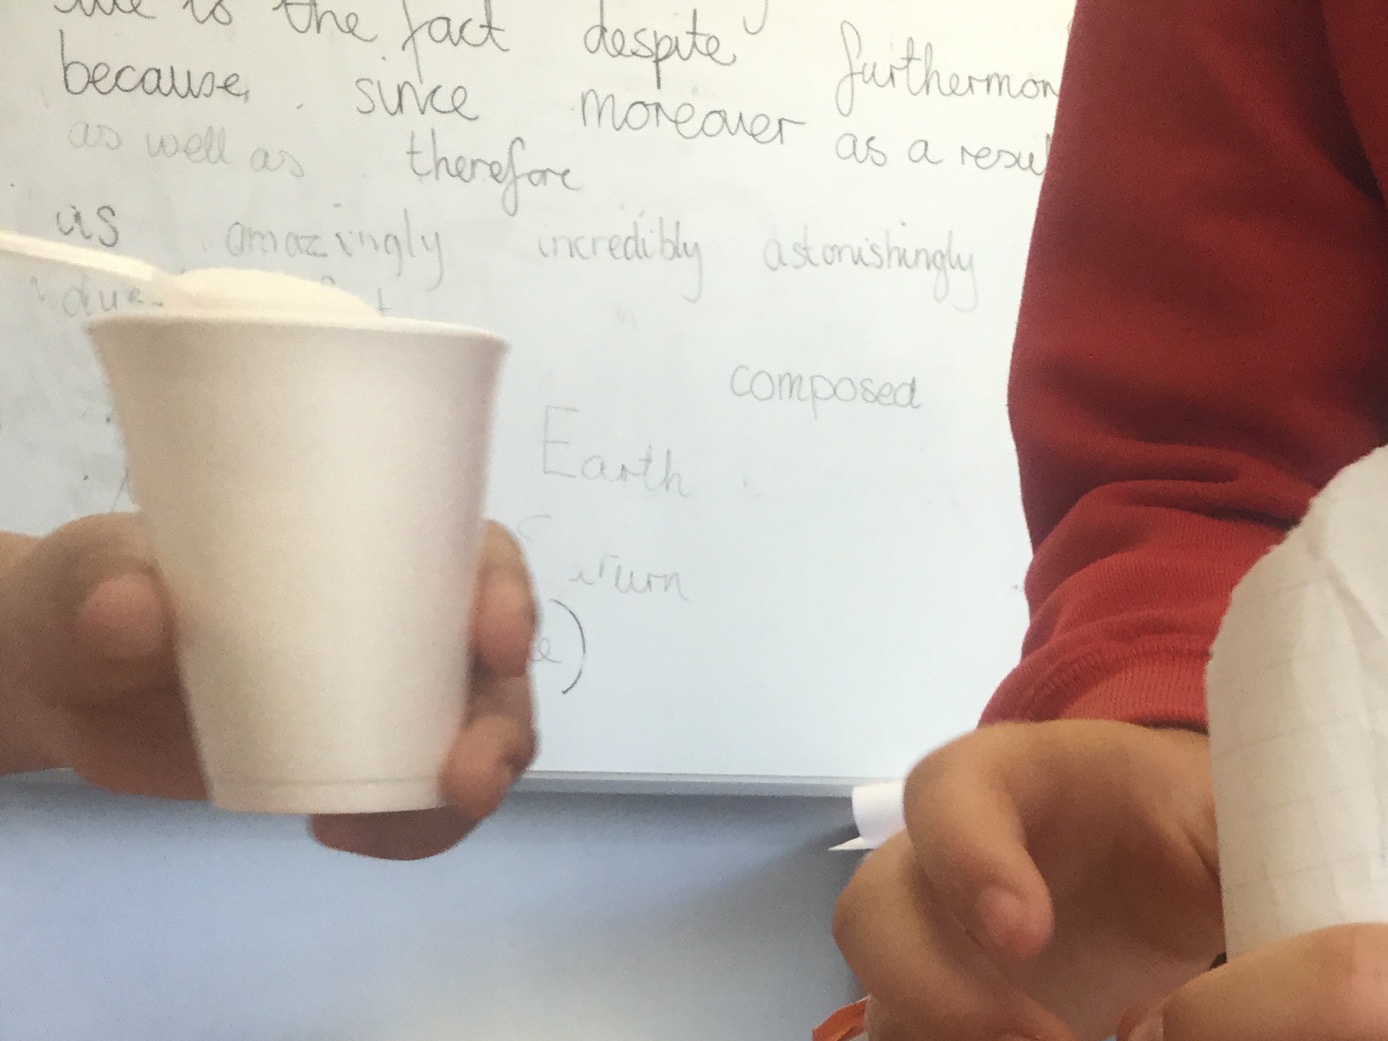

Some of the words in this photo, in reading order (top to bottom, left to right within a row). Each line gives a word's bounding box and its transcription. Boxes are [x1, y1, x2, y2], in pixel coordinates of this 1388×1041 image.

[273, 0, 377, 43] the
[402, 0, 509, 84] fact
[584, 2, 736, 90] despite
[836, 20, 1059, 117] furthermor
[356, 56, 479, 121] since
[836, 133, 887, 167] as
[908, 139, 943, 164] a
[69, 121, 122, 150] as
[147, 125, 230, 164] well
[250, 147, 305, 178] as
[406, 128, 583, 217] therefore
[226, 202, 443, 291] amazingly
[539, 211, 703, 303] incredibly
[763, 221, 978, 312] astonishingly
[730, 365, 922, 420] composed
[542, 405, 691, 498] Earth
